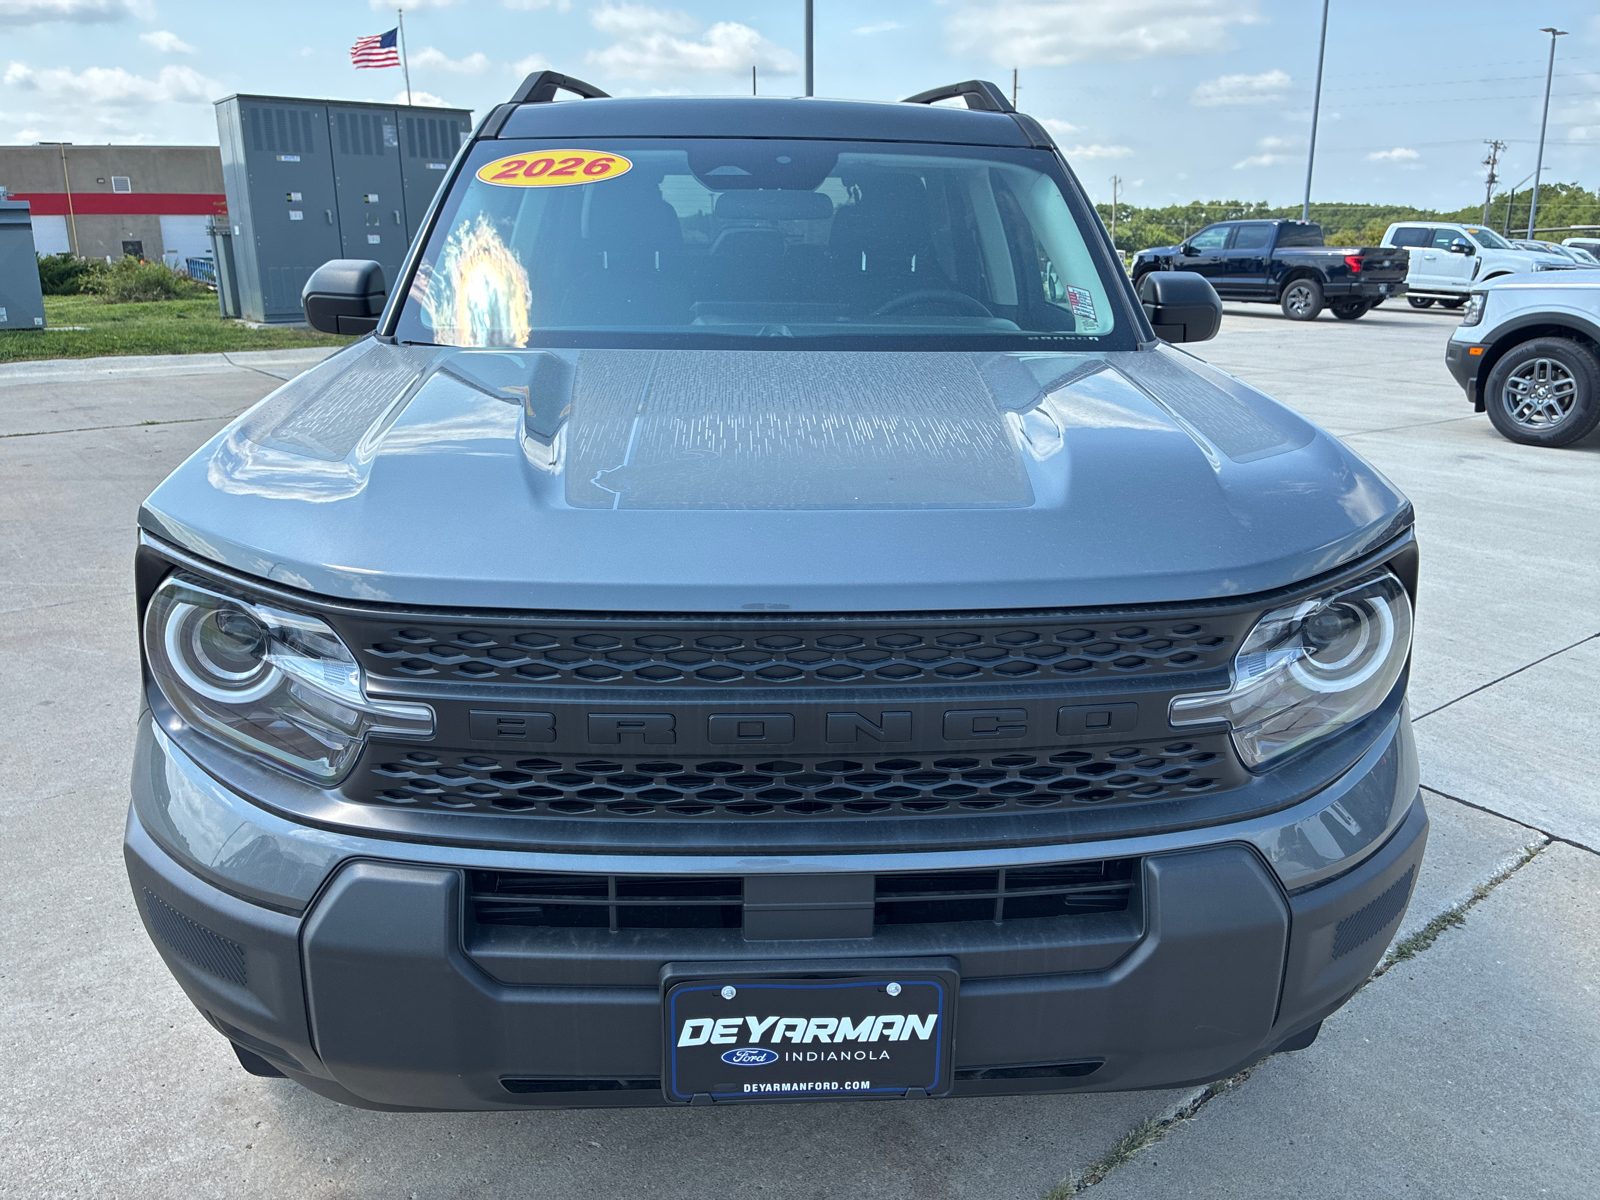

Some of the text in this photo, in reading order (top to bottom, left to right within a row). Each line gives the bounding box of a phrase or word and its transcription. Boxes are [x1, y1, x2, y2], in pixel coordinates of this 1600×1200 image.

[490, 157, 617, 181] 2026
[468, 701, 1139, 745] BRONCO
[677, 1013, 938, 1048] DEYARMAN
[732, 1050, 890, 1063] Ford INDIANOLA
[743, 1081, 870, 1093] DEYARMANFORD.COM
